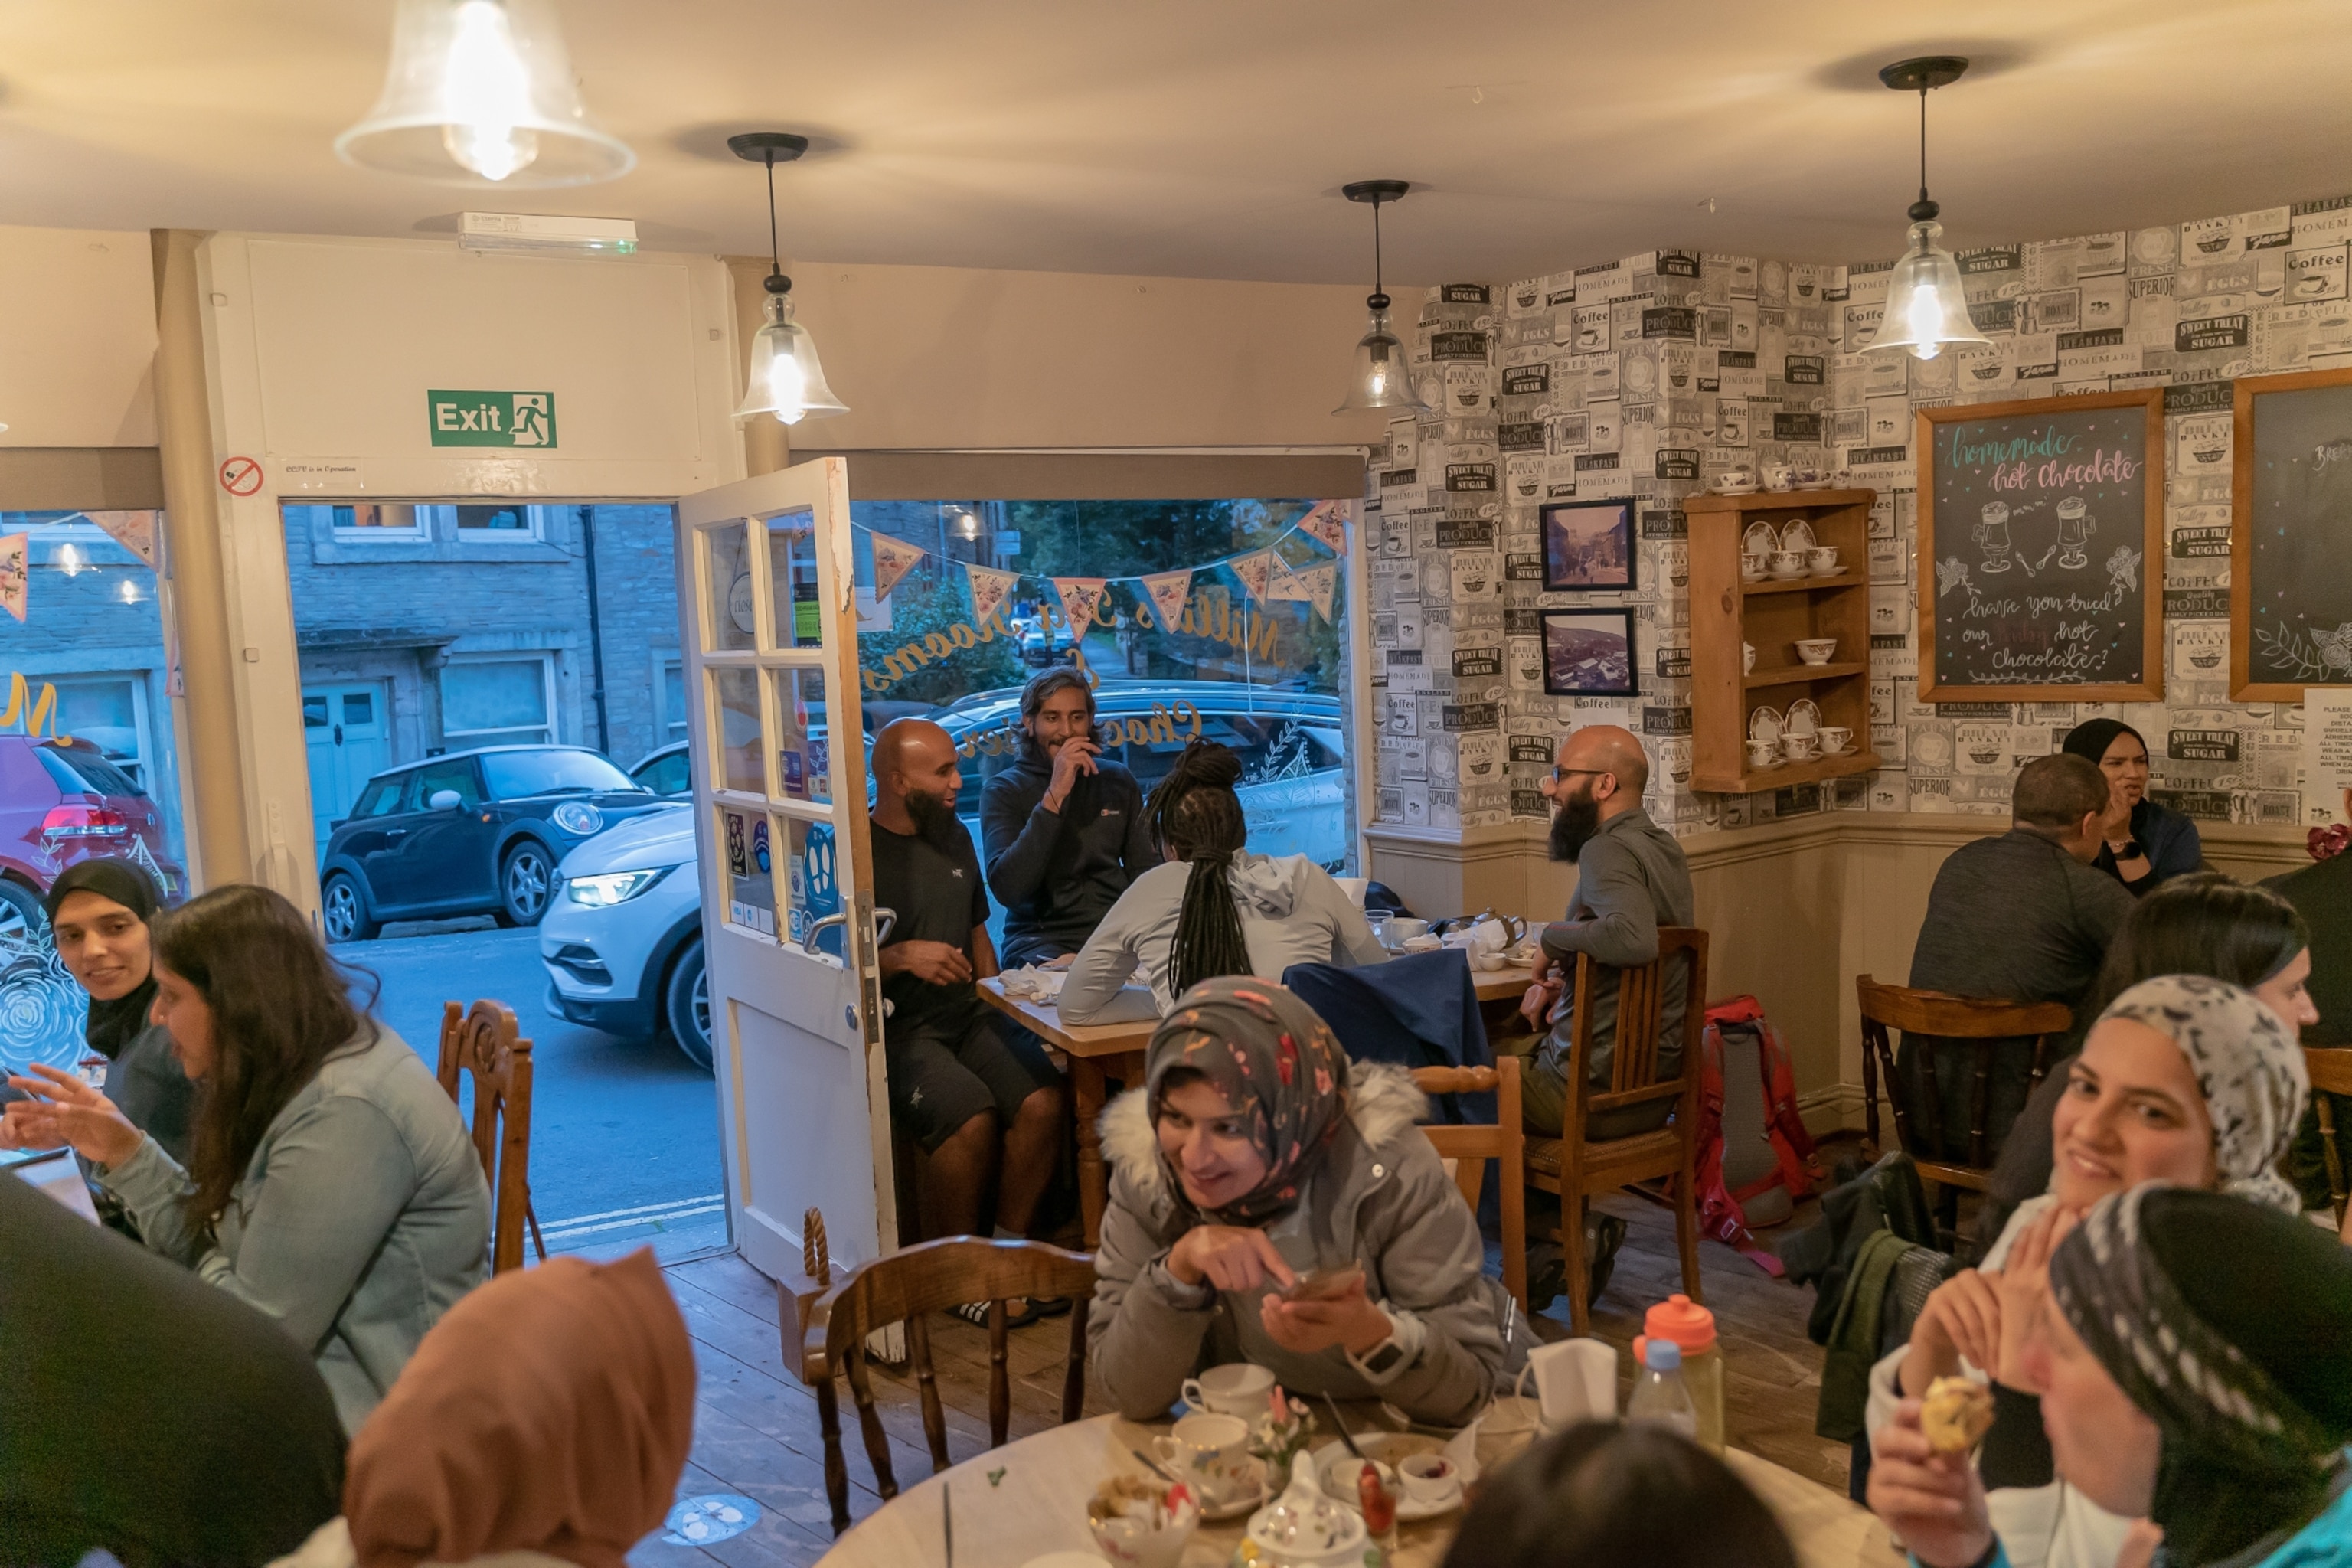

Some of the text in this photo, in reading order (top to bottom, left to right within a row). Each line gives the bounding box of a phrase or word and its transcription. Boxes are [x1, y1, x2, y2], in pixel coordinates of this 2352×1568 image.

[1968, 259, 2009, 272] SUGAR
[2288, 254, 2345, 270] Coffee
[1667, 263, 1694, 276] SUGAR
[2206, 274, 2250, 292] EGGS
[1451, 292, 1481, 301] SUGAR
[1573, 312, 1609, 325] Coffee
[2180, 319, 2211, 337] SWEET
[2213, 315, 2244, 330] TREAT
[2191, 335, 2235, 349] SUGAR
[1793, 374, 1818, 384] SUGAR
[1513, 381, 1541, 393] SUGAR
[436, 403, 502, 432] Exit
[1718, 406, 1747, 416] Coffee
[1950, 425, 2082, 469] homemade
[1448, 465, 1493, 478] SWEET TREAT
[1667, 468, 1692, 477] SUGAR
[1990, 460, 2034, 492] hot
[1457, 480, 1488, 490] SUGAR
[1381, 521, 1409, 531] Coffee
[2176, 528, 2207, 544] SWEET
[1962, 593, 2112, 619] have you tried
[1962, 629, 1993, 646] our
[2054, 620, 2099, 642] hot
[1455, 650, 1477, 663] SWEET
[1462, 665, 1493, 675] SUGAR
[1388, 699, 1415, 708] Coffee
[1576, 696, 1610, 709] Coffee
[2172, 731, 2236, 746] SWEET TREAT
[2261, 734, 2298, 744] RED
[1518, 750, 1547, 762] SUGAR
[2183, 747, 2226, 760] SUGAR
[2262, 805, 2292, 818] ROAST
